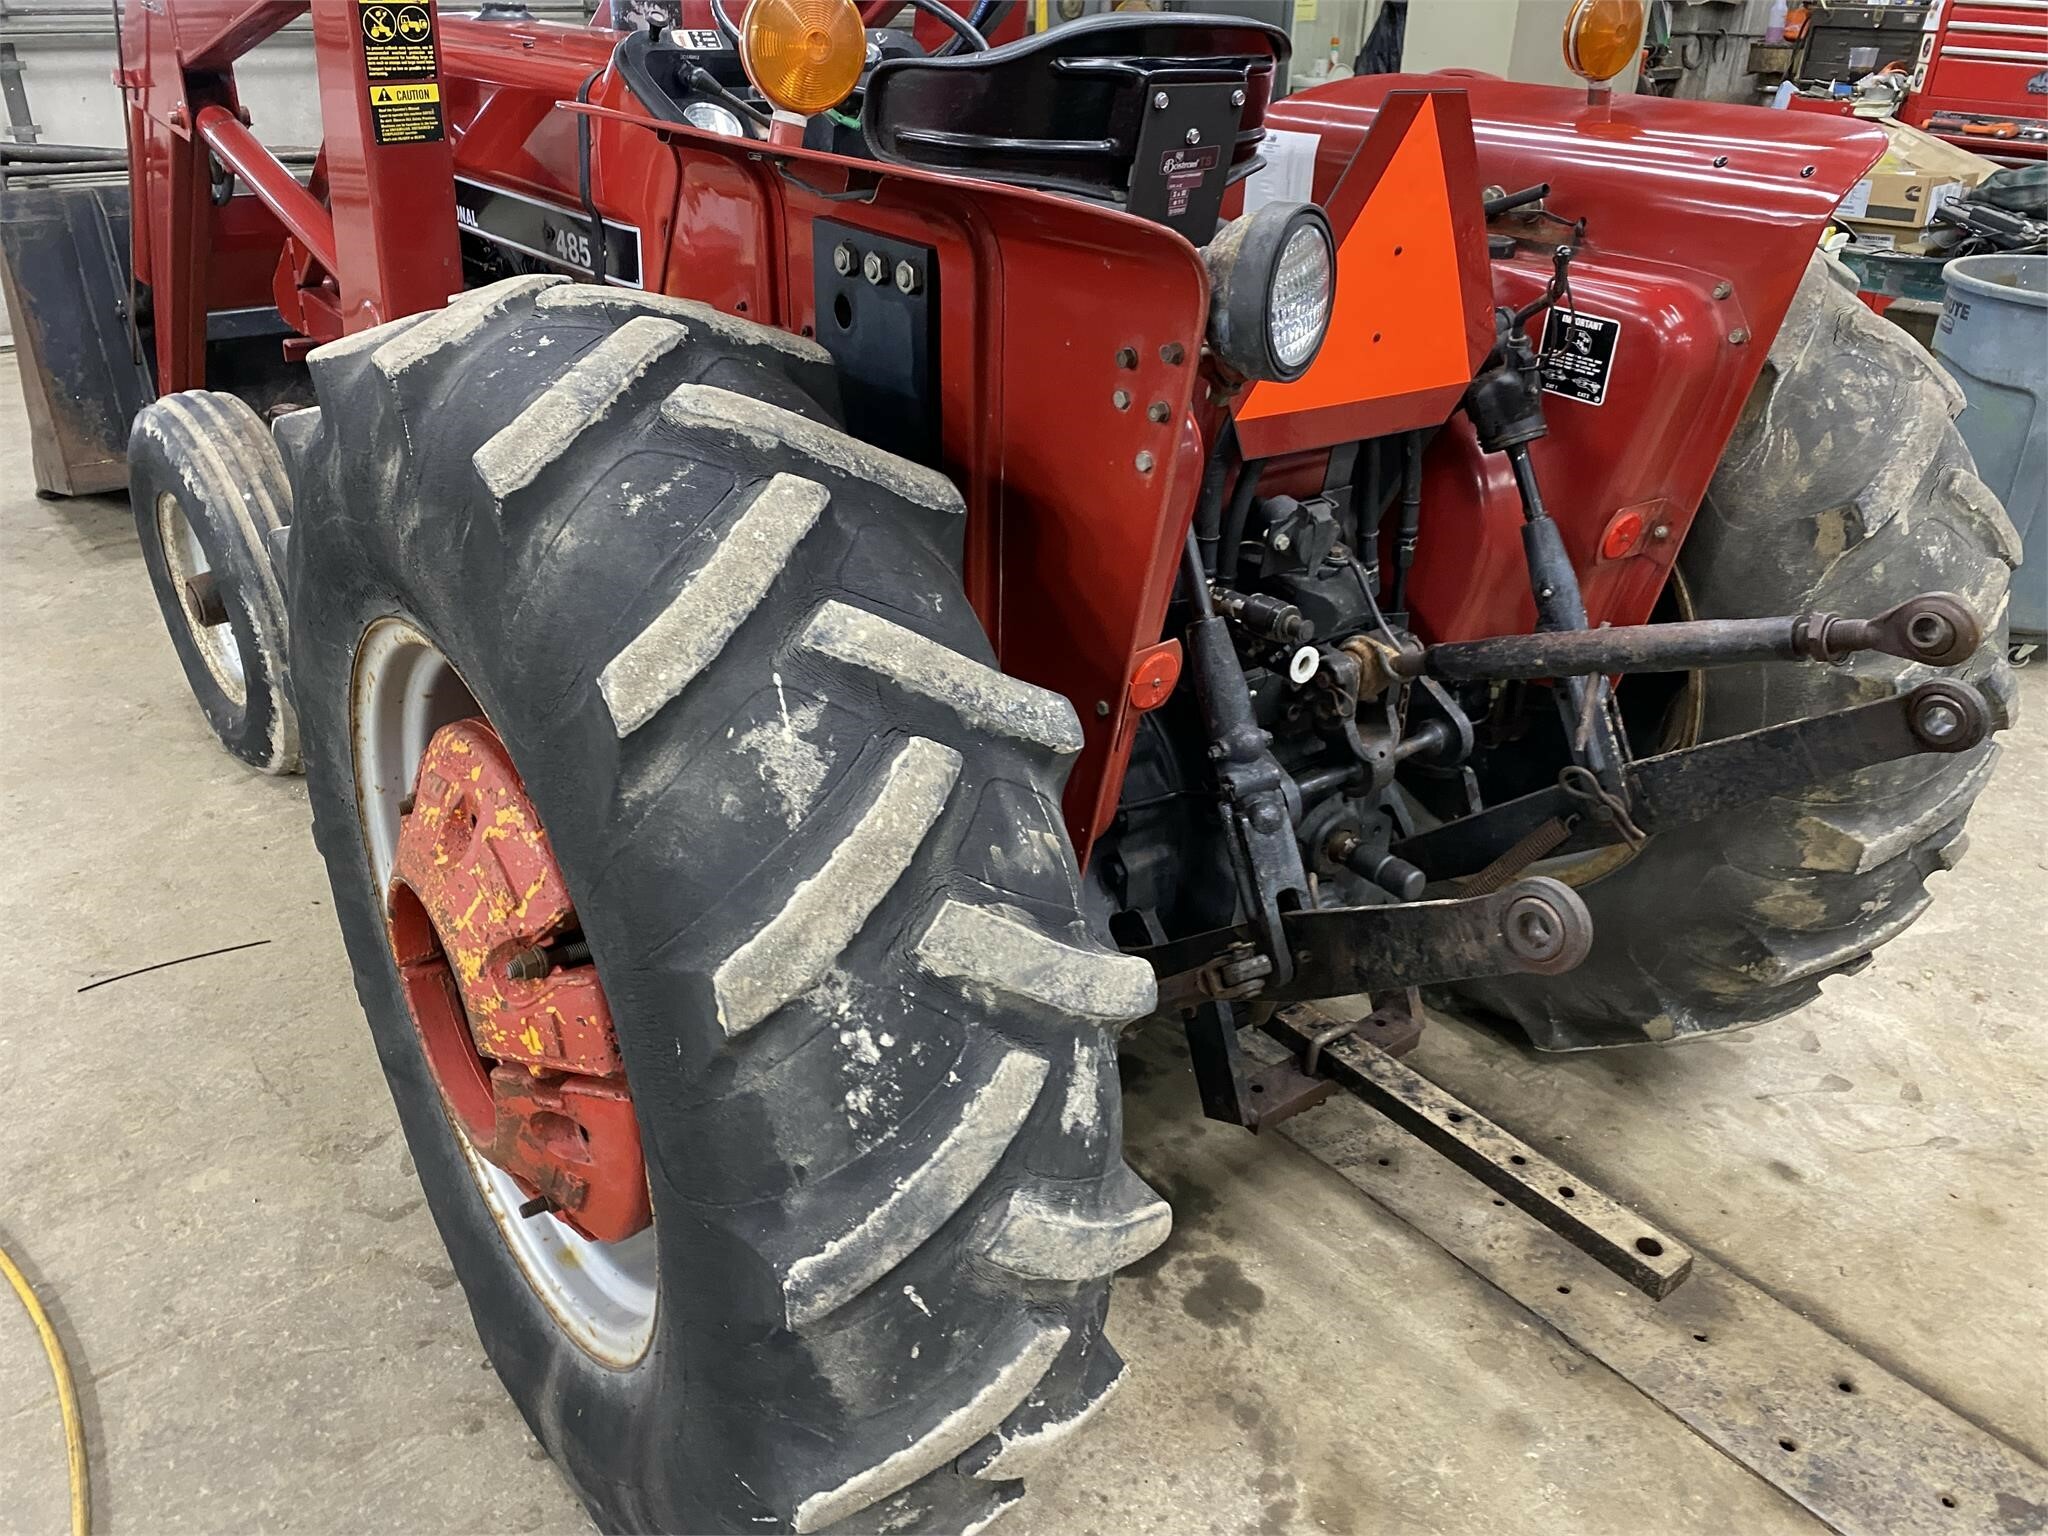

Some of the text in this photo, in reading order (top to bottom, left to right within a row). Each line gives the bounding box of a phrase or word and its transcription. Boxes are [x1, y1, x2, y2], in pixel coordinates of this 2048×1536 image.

[396, 89, 430, 101] CAUTION
[556, 229, 592, 268] 485
[1562, 313, 1604, 331] IMORTANT
